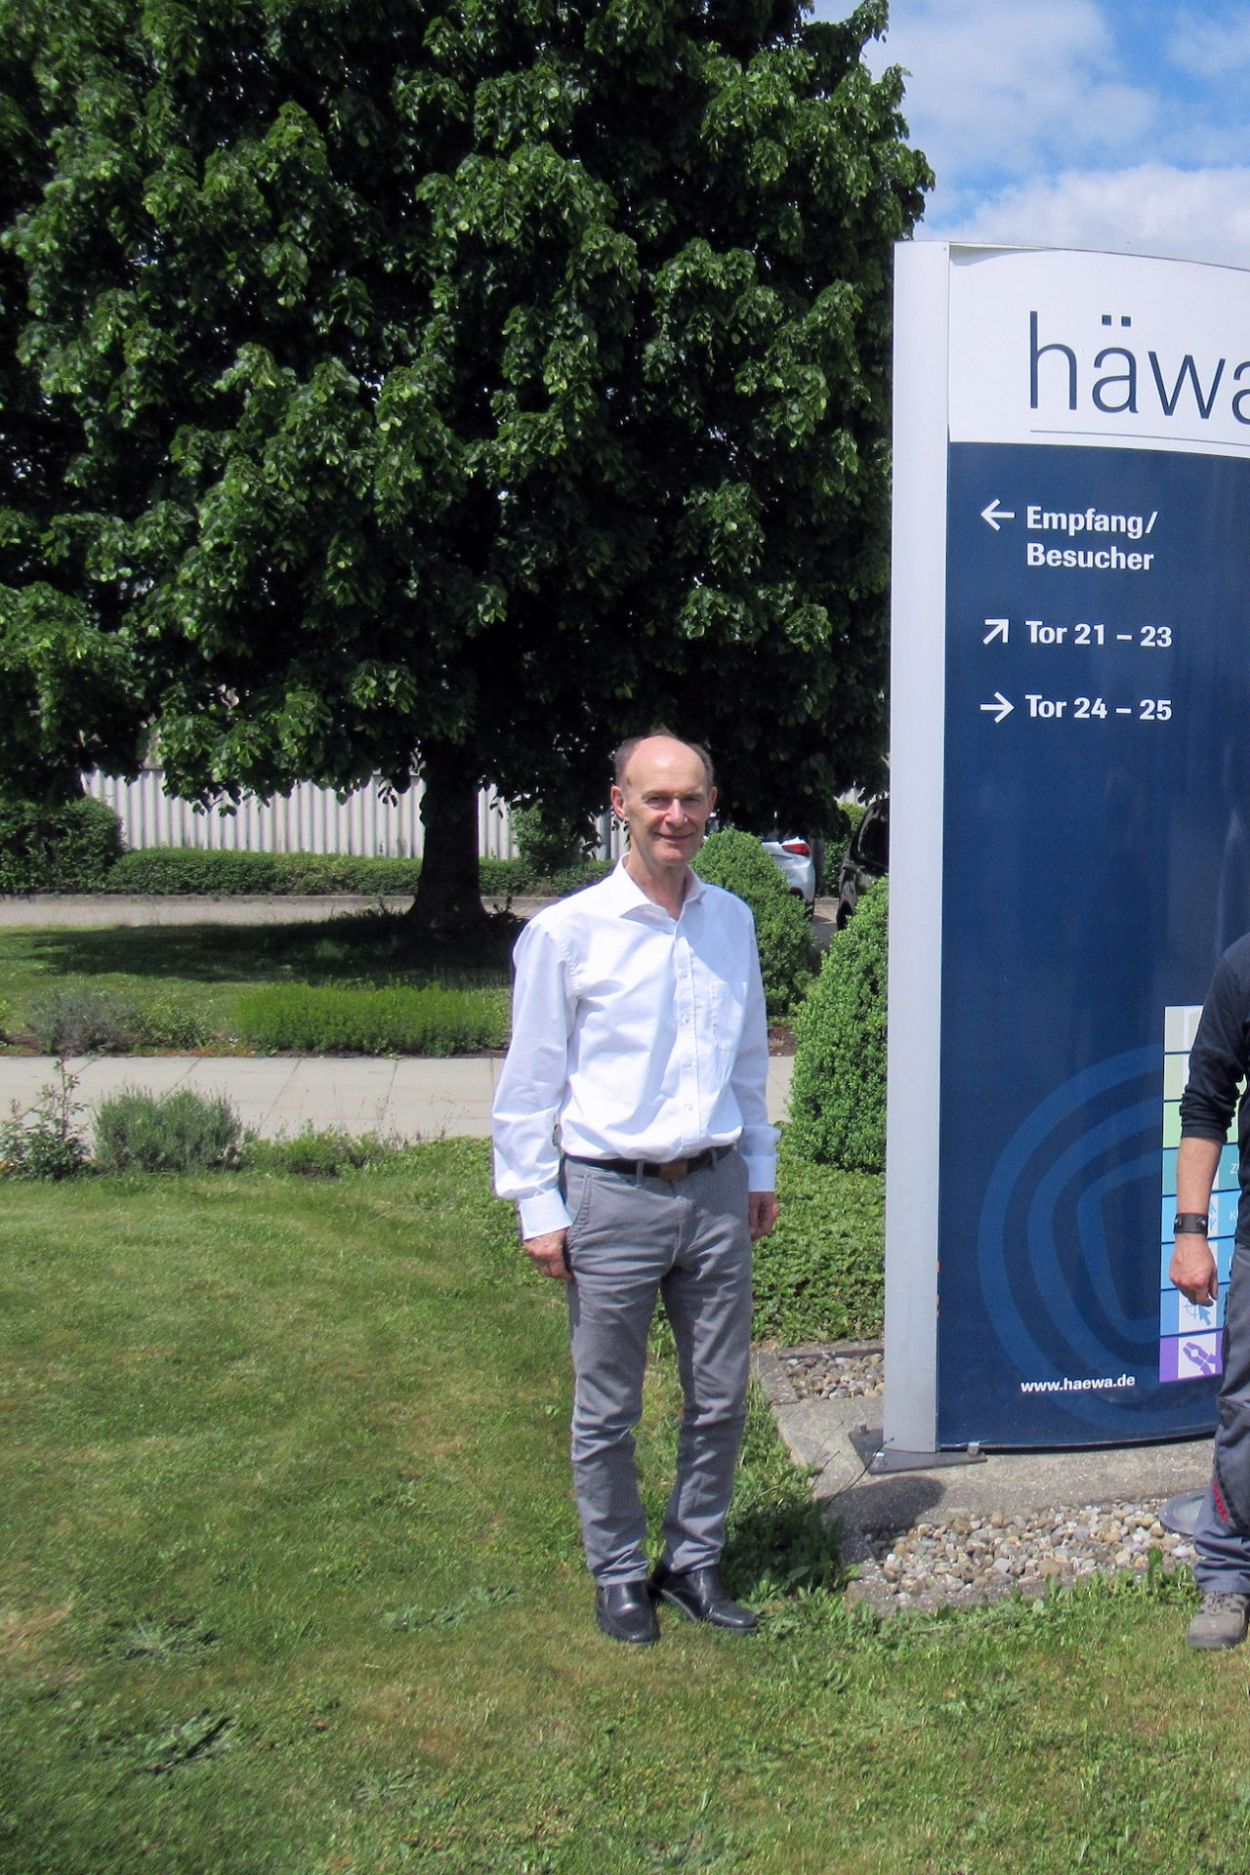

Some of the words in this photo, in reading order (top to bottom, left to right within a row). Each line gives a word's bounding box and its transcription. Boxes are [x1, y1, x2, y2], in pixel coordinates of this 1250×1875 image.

[1027, 505, 1158, 539] Empfang/
[1027, 542, 1154, 570] Besucher
[1025, 620, 1068, 644] Tor
[1074, 623, 1105, 645] 21
[1140, 625, 1173, 648] 23
[1025, 694, 1067, 718] Tor
[1073, 697, 1108, 719] 24
[1139, 699, 1173, 721] 25
[1020, 1374, 1136, 1393] www.haewa.de
